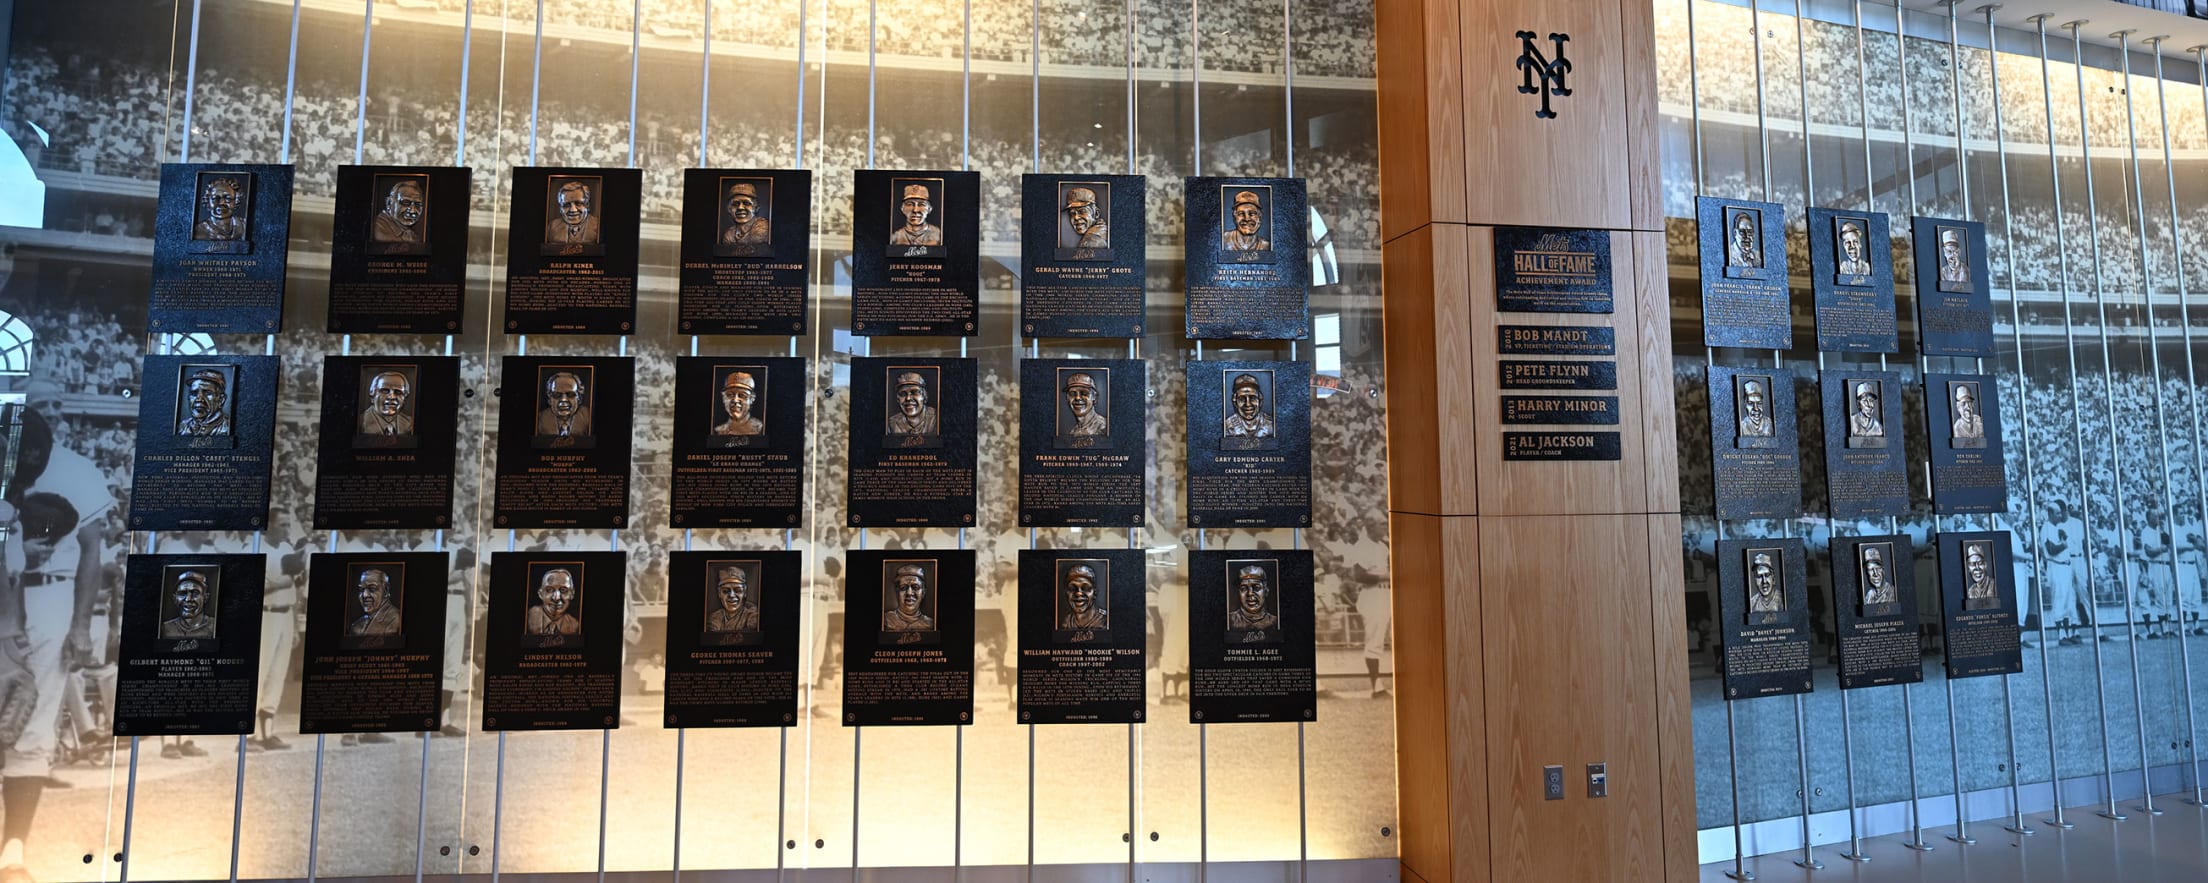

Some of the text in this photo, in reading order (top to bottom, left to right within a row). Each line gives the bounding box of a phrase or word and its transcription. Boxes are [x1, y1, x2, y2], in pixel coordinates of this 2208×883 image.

[1516, 30, 1572, 119] NY
[1514, 254, 1596, 273] HALL OF FAME
[1514, 330, 1588, 341] BOB MANDT
[1516, 365, 1588, 376] PETE FLYNN
[1507, 400, 1515, 419] 2013
[1518, 400, 1607, 411] HARRY MINOR
[1519, 436, 1594, 449] AL JACKSON
